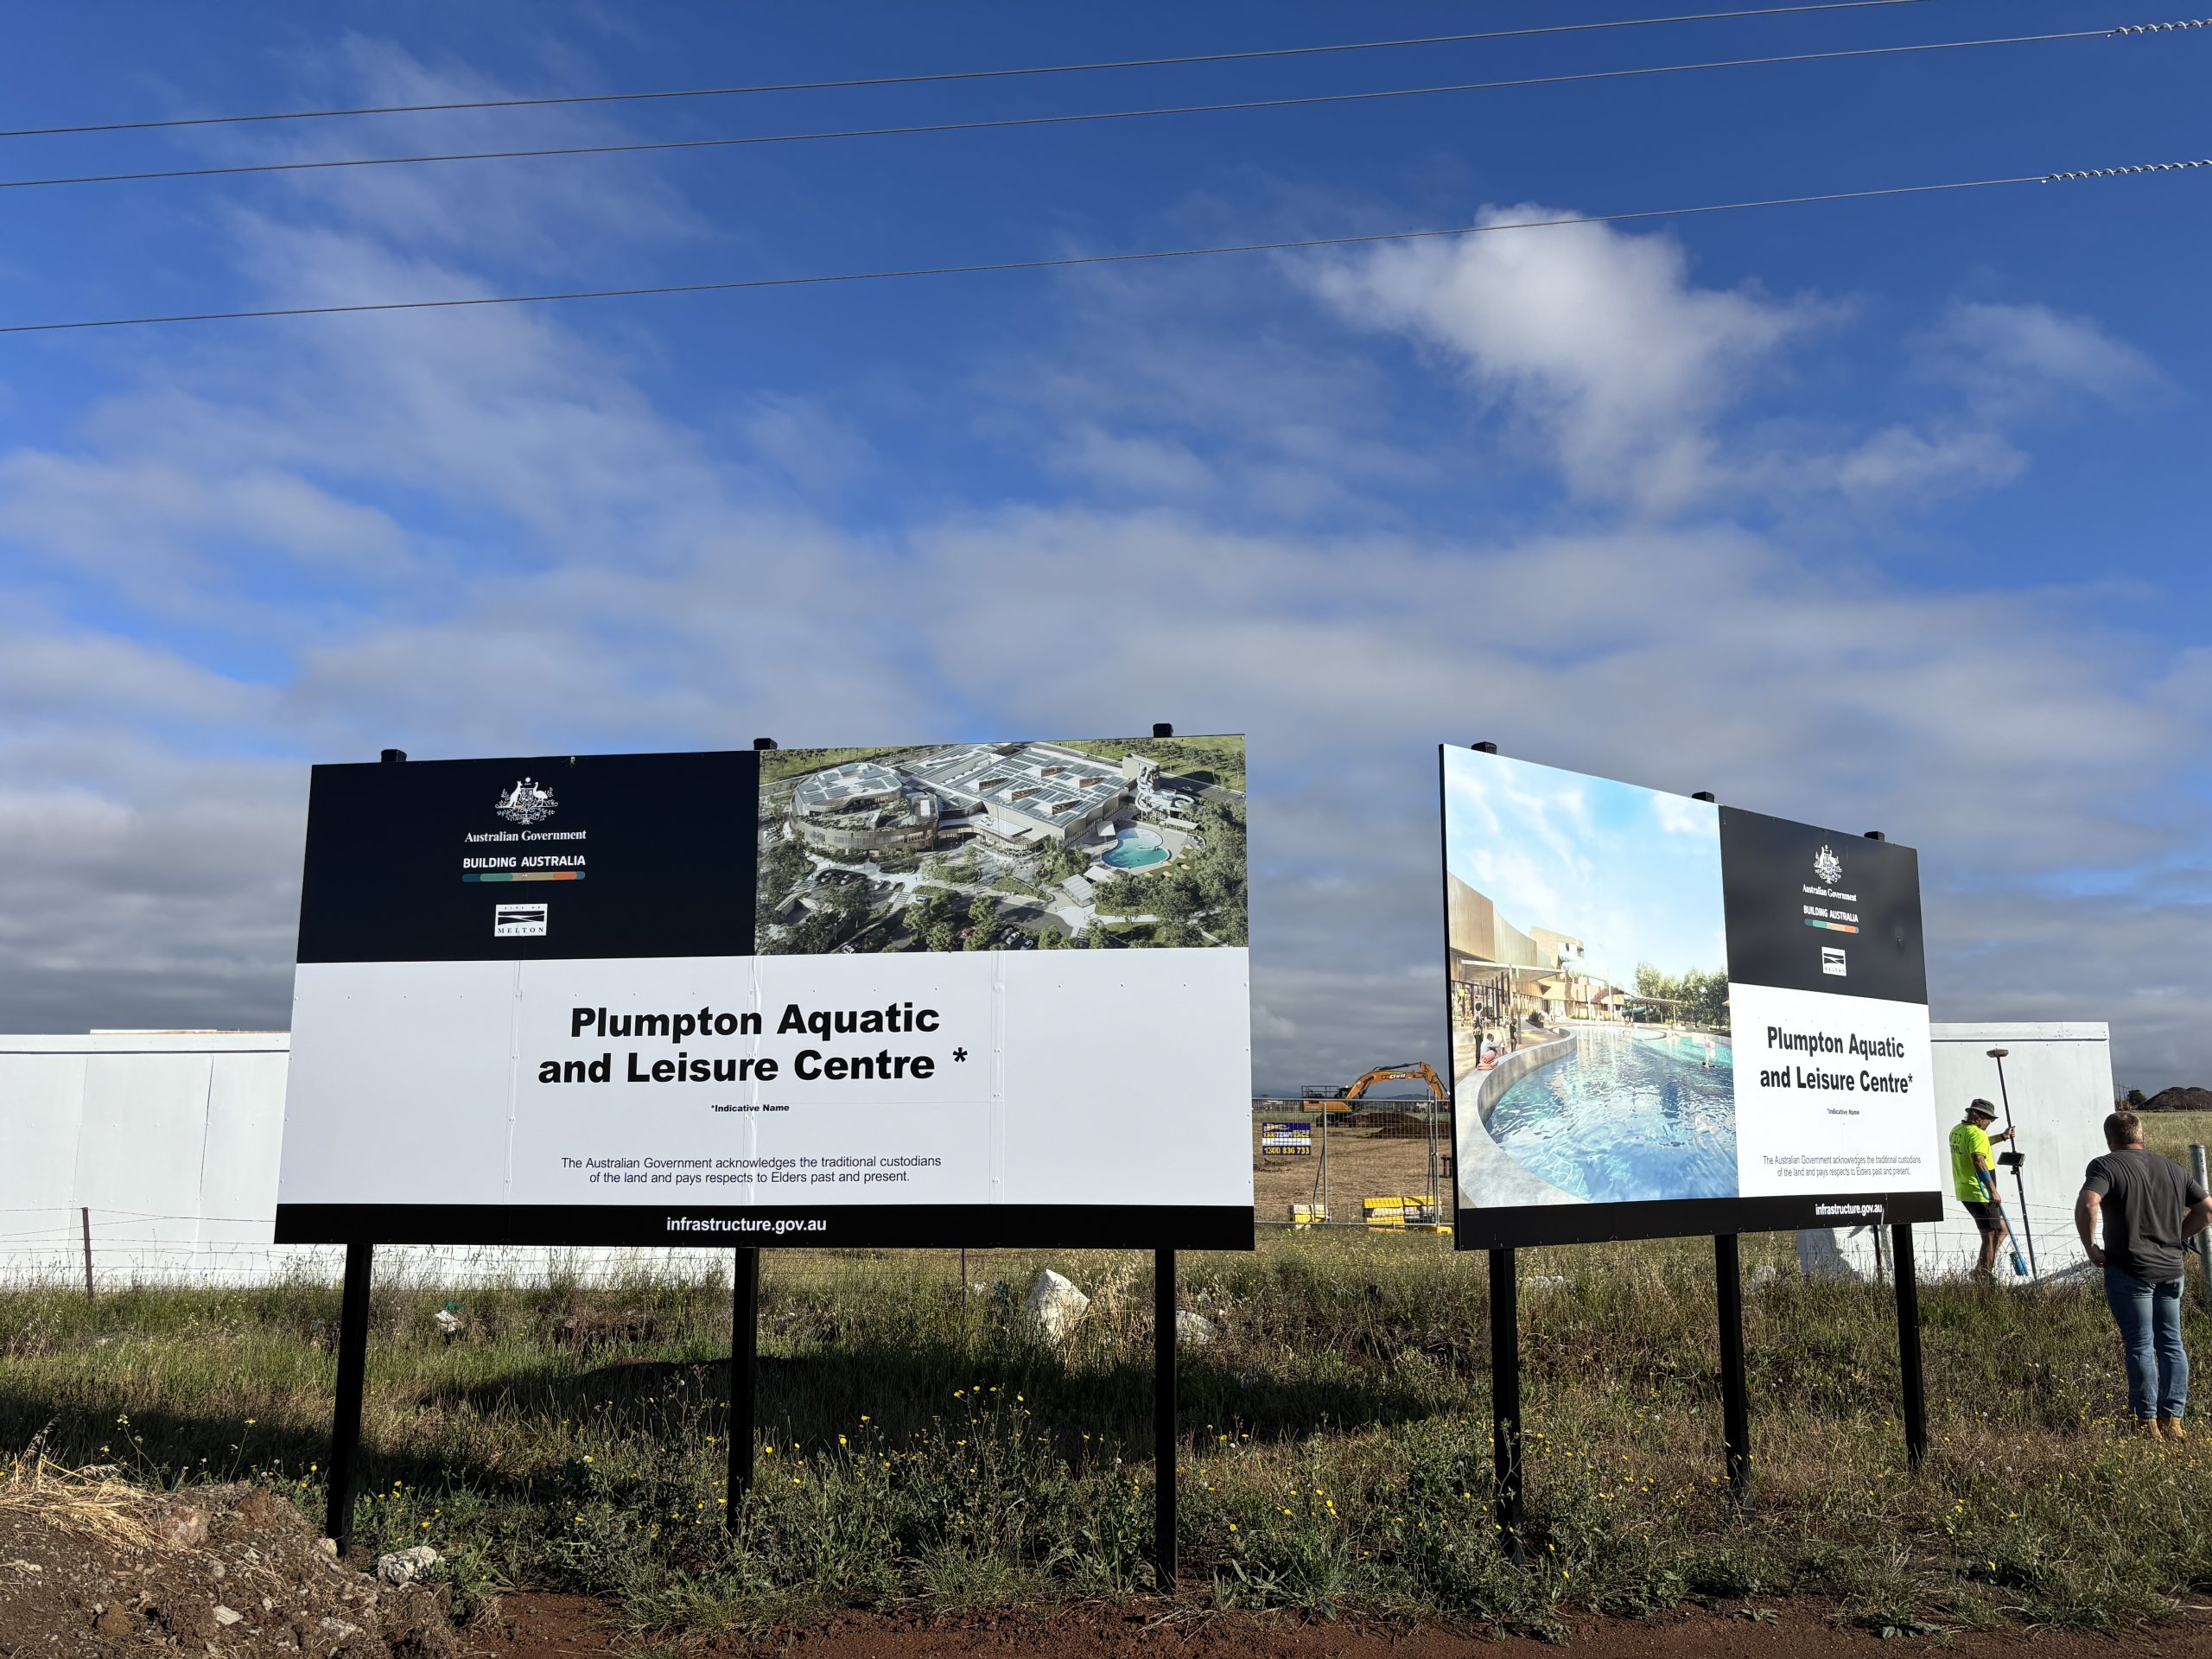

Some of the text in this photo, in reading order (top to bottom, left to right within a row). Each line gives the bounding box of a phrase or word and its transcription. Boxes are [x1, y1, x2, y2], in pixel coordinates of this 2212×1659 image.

[464, 830, 587, 842] Australian Government
[462, 855, 586, 868] BUILDING AUSTRALIA
[1802, 884, 1857, 901] Australian Government
[1803, 905, 1859, 923] BUILDING AUSTRALIA
[571, 1002, 940, 1044] Plumpton Aquatic
[1767, 1027, 1904, 1060] Plumpton Aquatic
[538, 1052, 611, 1084] and
[627, 1052, 779, 1083] Leisure
[794, 1049, 935, 1081] Centre
[1760, 1065, 1791, 1088] and
[1796, 1066, 1855, 1091] Leisure
[562, 1155, 942, 1170] The Australian Government acknowledges the traditional custodians
[1763, 1155, 1921, 1166] The Australian Government acknowledges the traditional custodians
[589, 1171, 910, 1185] of the land and pays respects to Elders past and present.
[1777, 1167, 1783, 1177] of
[1816, 1169, 1828, 1178] pays
[1829, 1168, 1850, 1178] respects
[1856, 1167, 1872, 1176] Elders
[1872, 1168, 1883, 1177] past
[1892, 1167, 1910, 1177] present.
[1815, 1204, 1883, 1217] infrastructure.gov.au
[666, 1217, 827, 1234] infrastructure.gov.au
